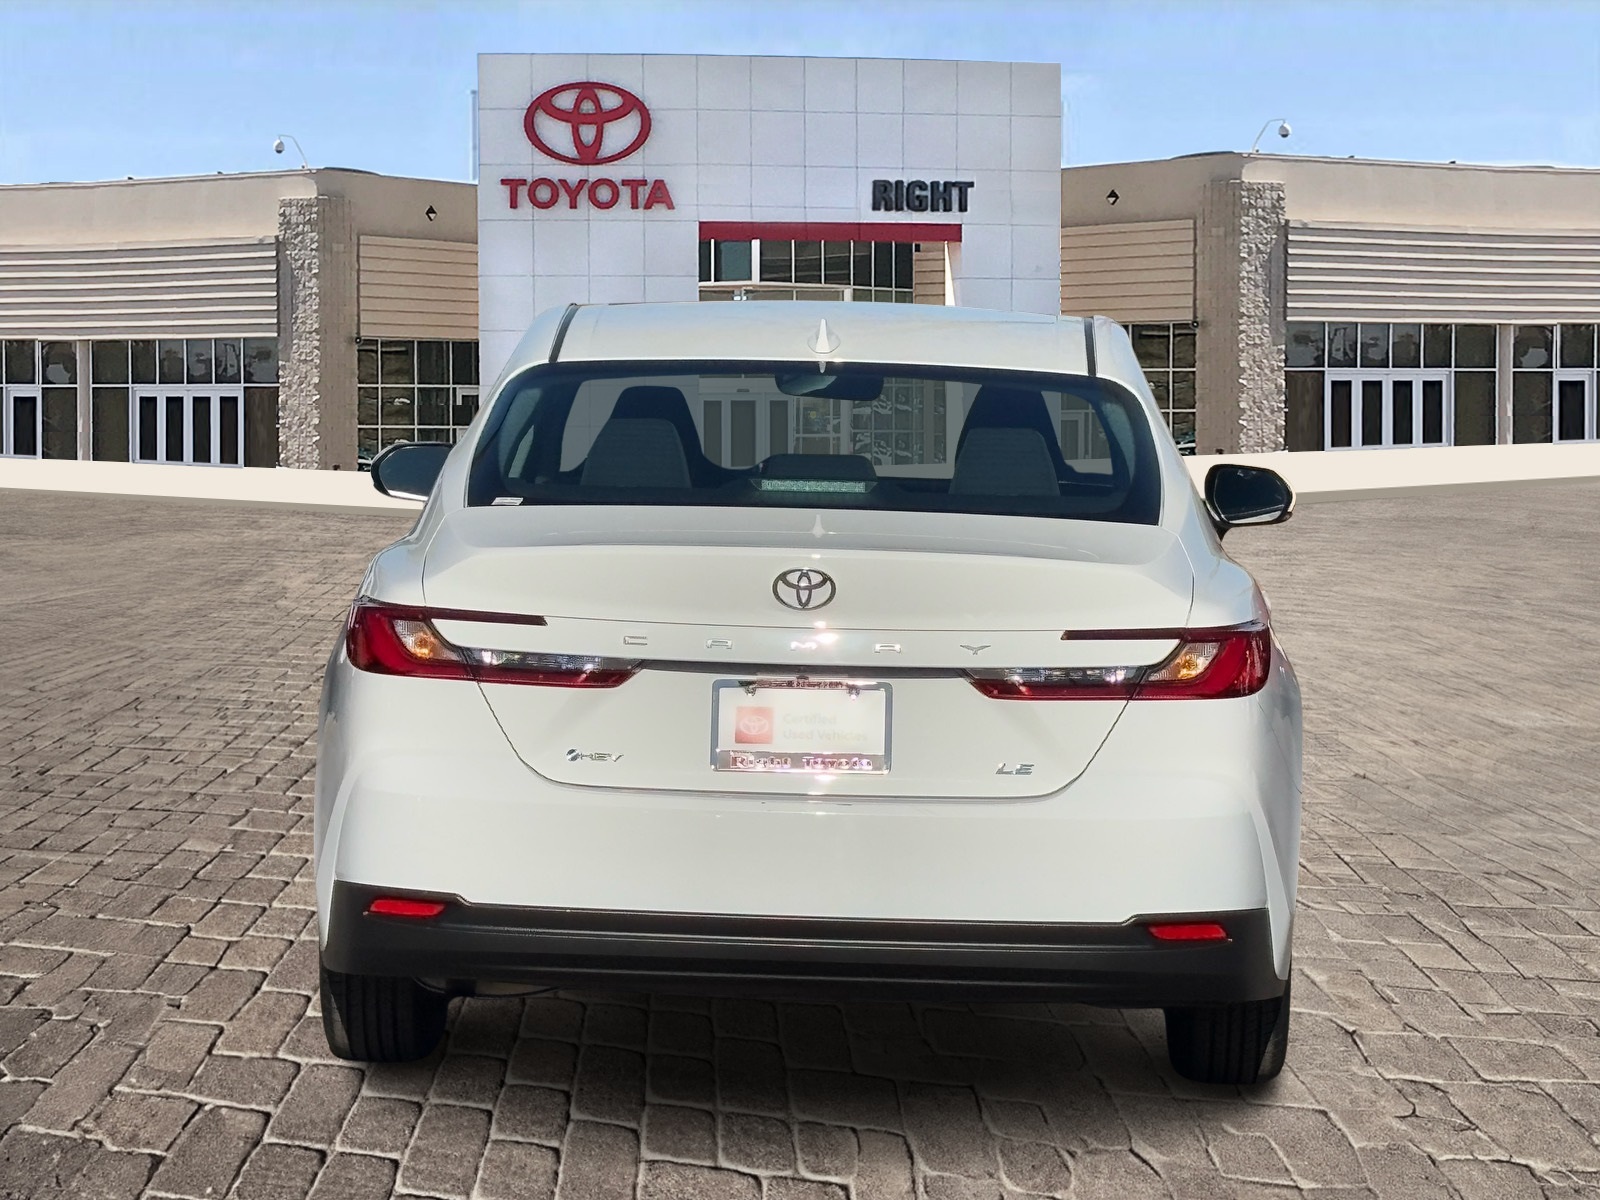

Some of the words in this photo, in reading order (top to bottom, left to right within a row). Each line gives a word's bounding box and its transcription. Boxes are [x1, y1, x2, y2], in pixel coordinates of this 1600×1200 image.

[500, 178, 675, 210] TOYOTA
[871, 179, 975, 212] RIGHT
[623, 634, 991, 655] CAMRY
[783, 712, 837, 725] Certified
[783, 729, 814, 740] Used
[817, 728, 868, 742] Vehicles
[995, 763, 1035, 776] LE
